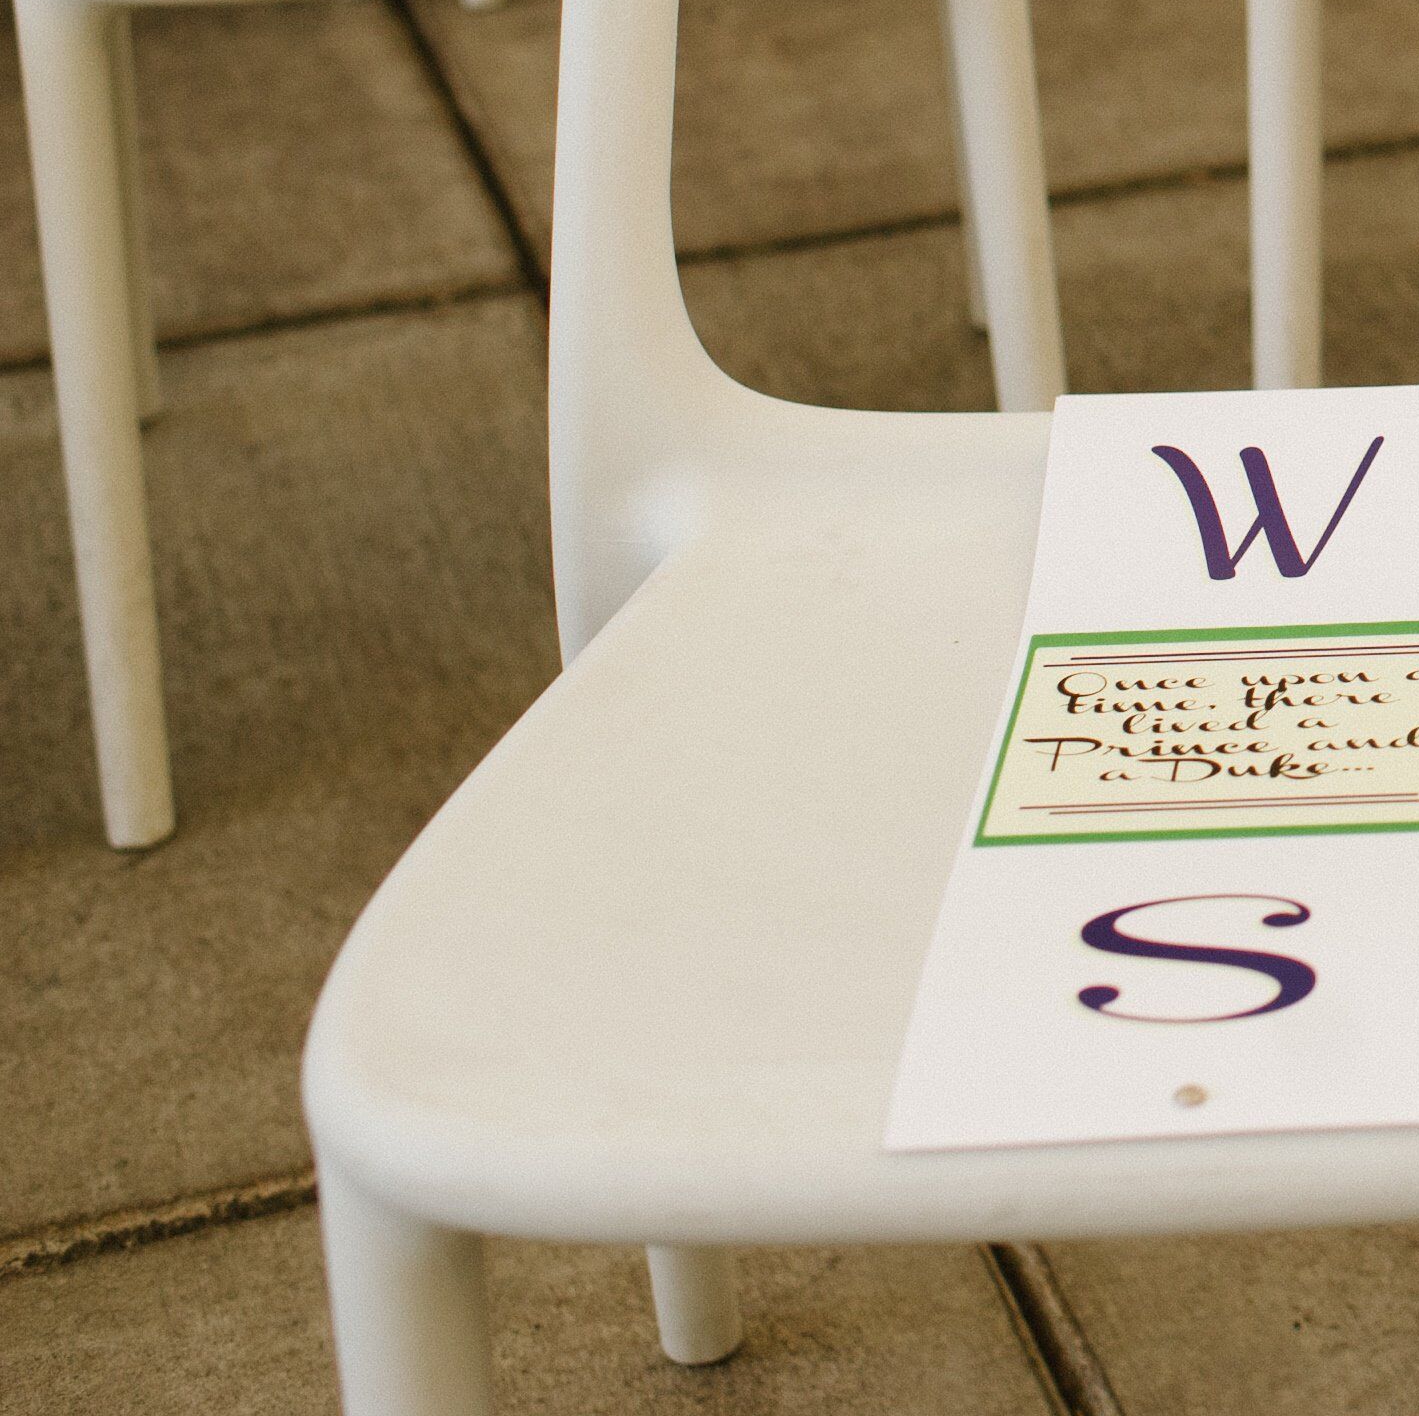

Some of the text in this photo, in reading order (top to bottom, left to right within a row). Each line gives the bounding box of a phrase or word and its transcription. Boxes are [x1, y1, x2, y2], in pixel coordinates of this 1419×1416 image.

[1151, 435, 1385, 581] W
[1057, 671, 1218, 697] Once
[1241, 669, 1380, 692] upon
[1239, 687, 1400, 711] there
[1122, 710, 1339, 734] lived a
[1023, 737, 1279, 772] Prince
[1099, 754, 1375, 783] a Duke...
[1076, 894, 1317, 1024] S
